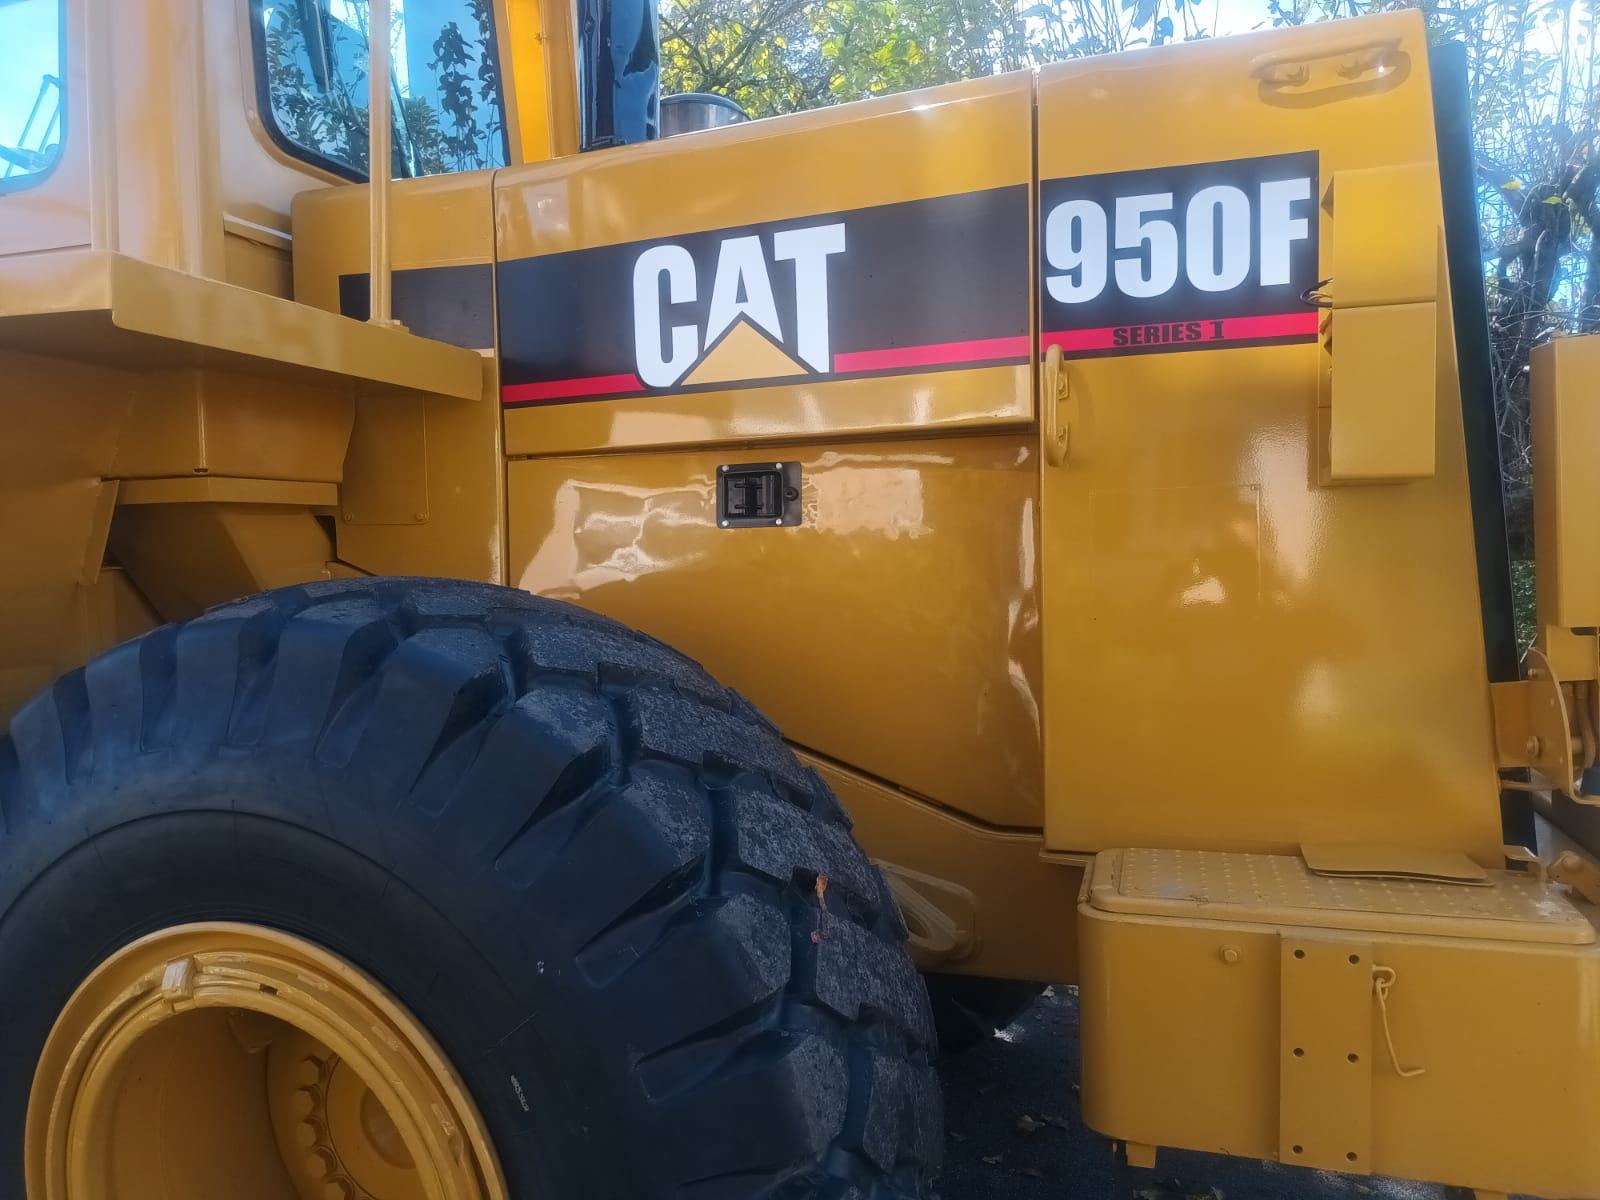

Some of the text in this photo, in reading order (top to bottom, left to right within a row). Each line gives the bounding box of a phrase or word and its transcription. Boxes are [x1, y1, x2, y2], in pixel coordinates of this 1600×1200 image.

[1046, 177, 1311, 304] 950F
[633, 222, 846, 389] CAT
[1113, 320, 1224, 346] SERIES I
